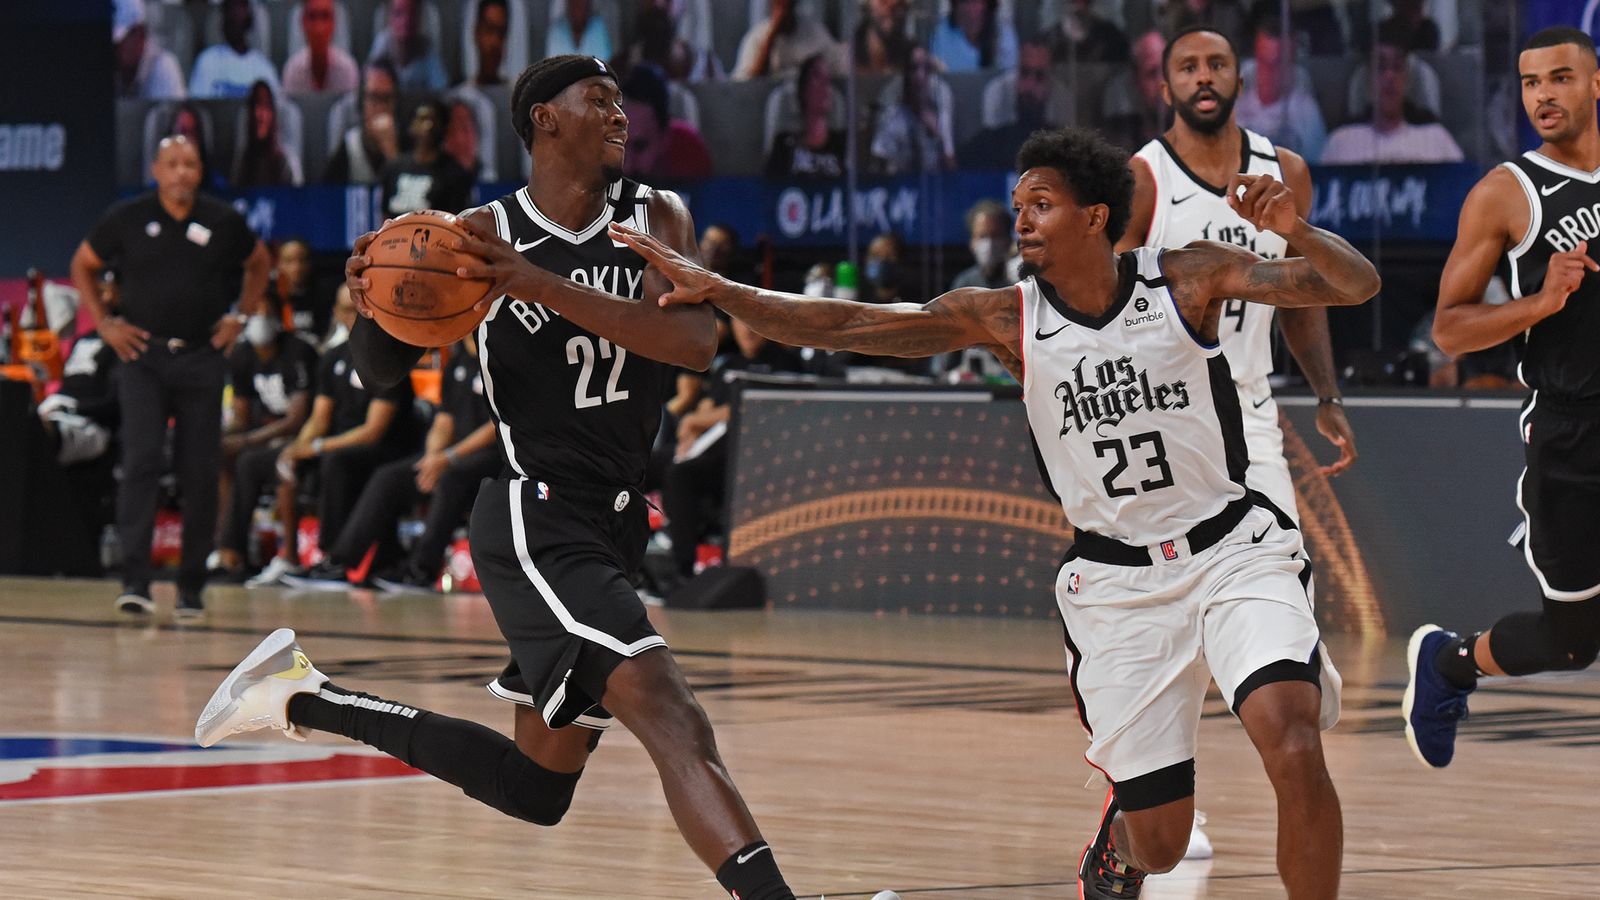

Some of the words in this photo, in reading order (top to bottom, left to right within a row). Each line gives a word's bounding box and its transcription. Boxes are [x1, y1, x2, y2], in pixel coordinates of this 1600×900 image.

[1124, 311, 1164, 327] bumble
[565, 335, 629, 409] 22
[1054, 368, 1190, 440] Angeles
[1072, 356, 1137, 397] Los
[1092, 430, 1175, 498] 23
